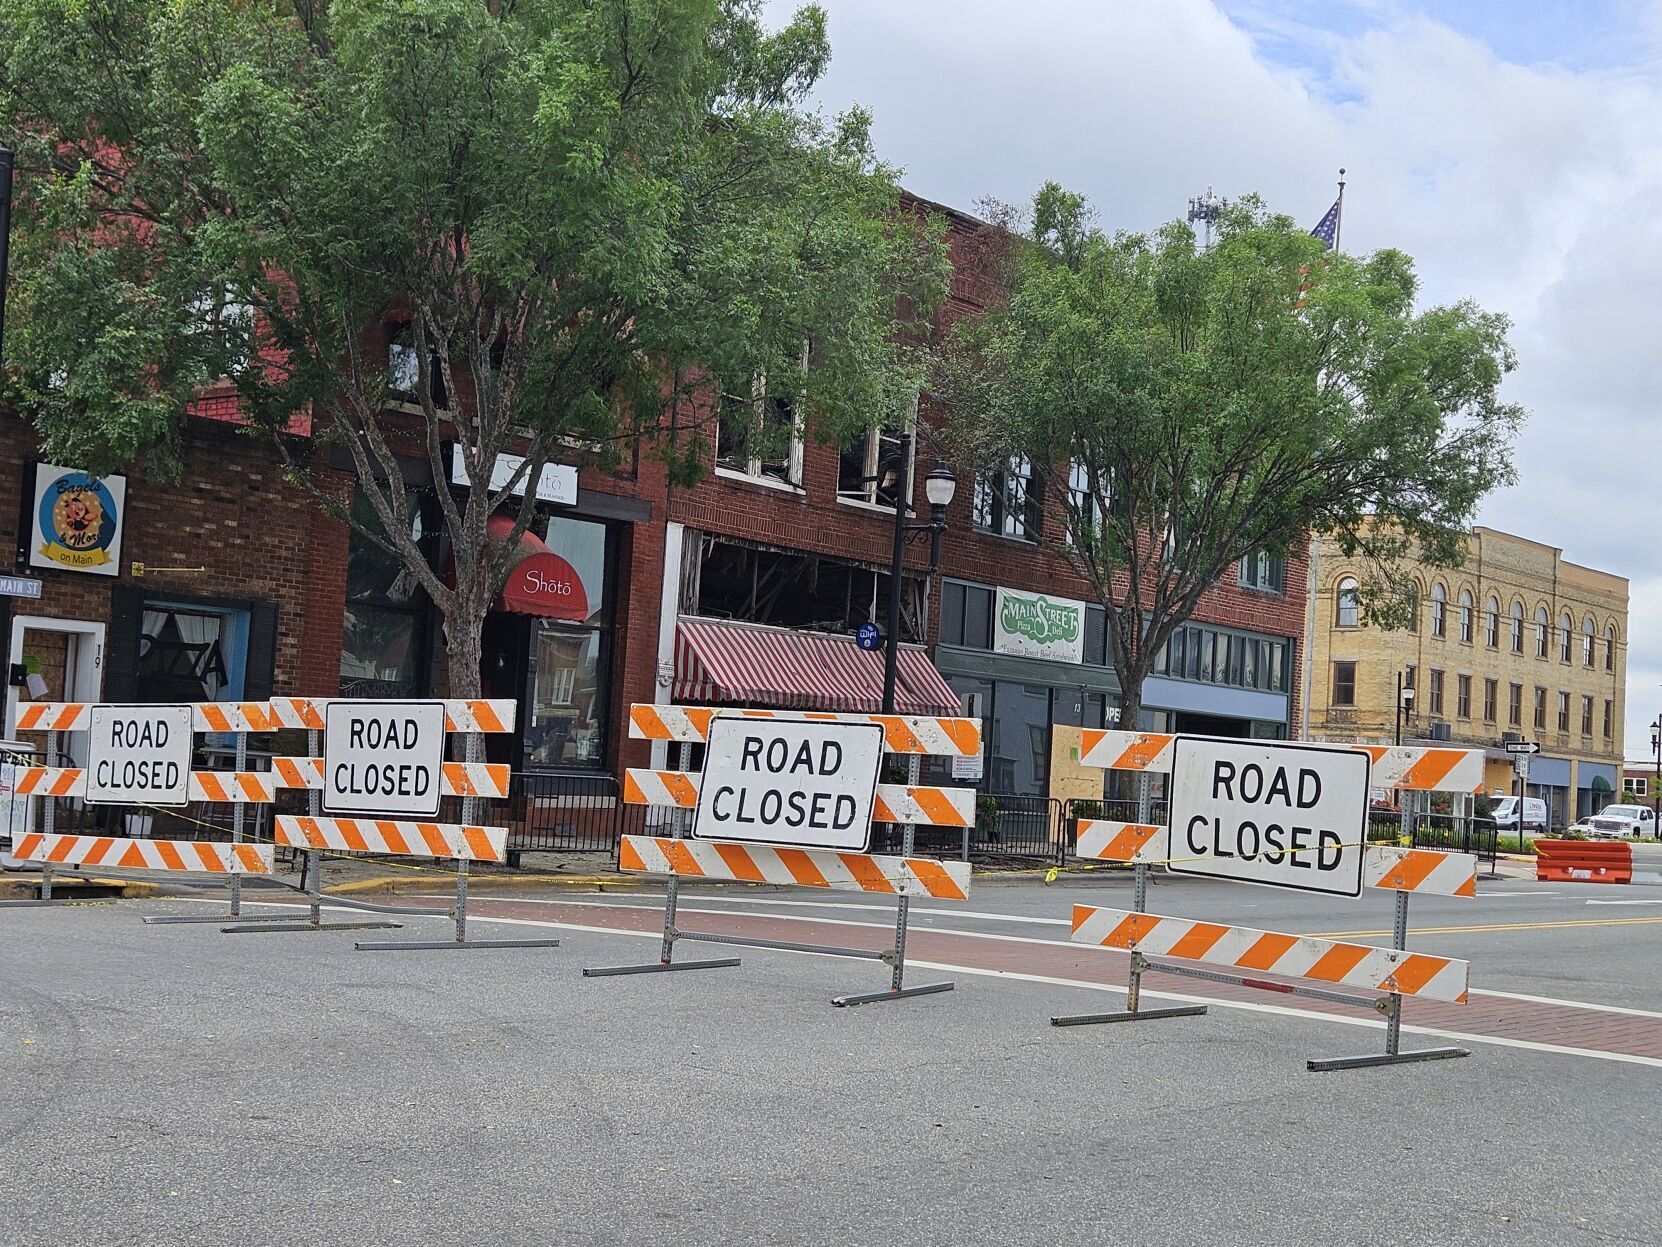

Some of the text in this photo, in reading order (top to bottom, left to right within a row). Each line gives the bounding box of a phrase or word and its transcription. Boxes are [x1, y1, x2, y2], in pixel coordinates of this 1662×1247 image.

[55, 479, 101, 497] Bagels
[59, 532, 67, 543] &
[60, 553, 93, 565] on Main
[0, 578, 23, 593] MAIN
[523, 570, 571, 596] Shōtō
[1017, 620, 1063, 635] Pizza Deli
[1074, 703, 1081, 713] 13
[1105, 706, 1121, 722] PE
[111, 719, 169, 748] ROAD
[350, 718, 419, 750] ROAD
[740, 736, 843, 776] ROAD
[97, 760, 179, 790] CLOSED
[335, 763, 430, 797] CLOSED
[1212, 760, 1322, 809] ROAD
[712, 786, 857, 830] CLOSED
[1186, 815, 1343, 872] CLOSED
